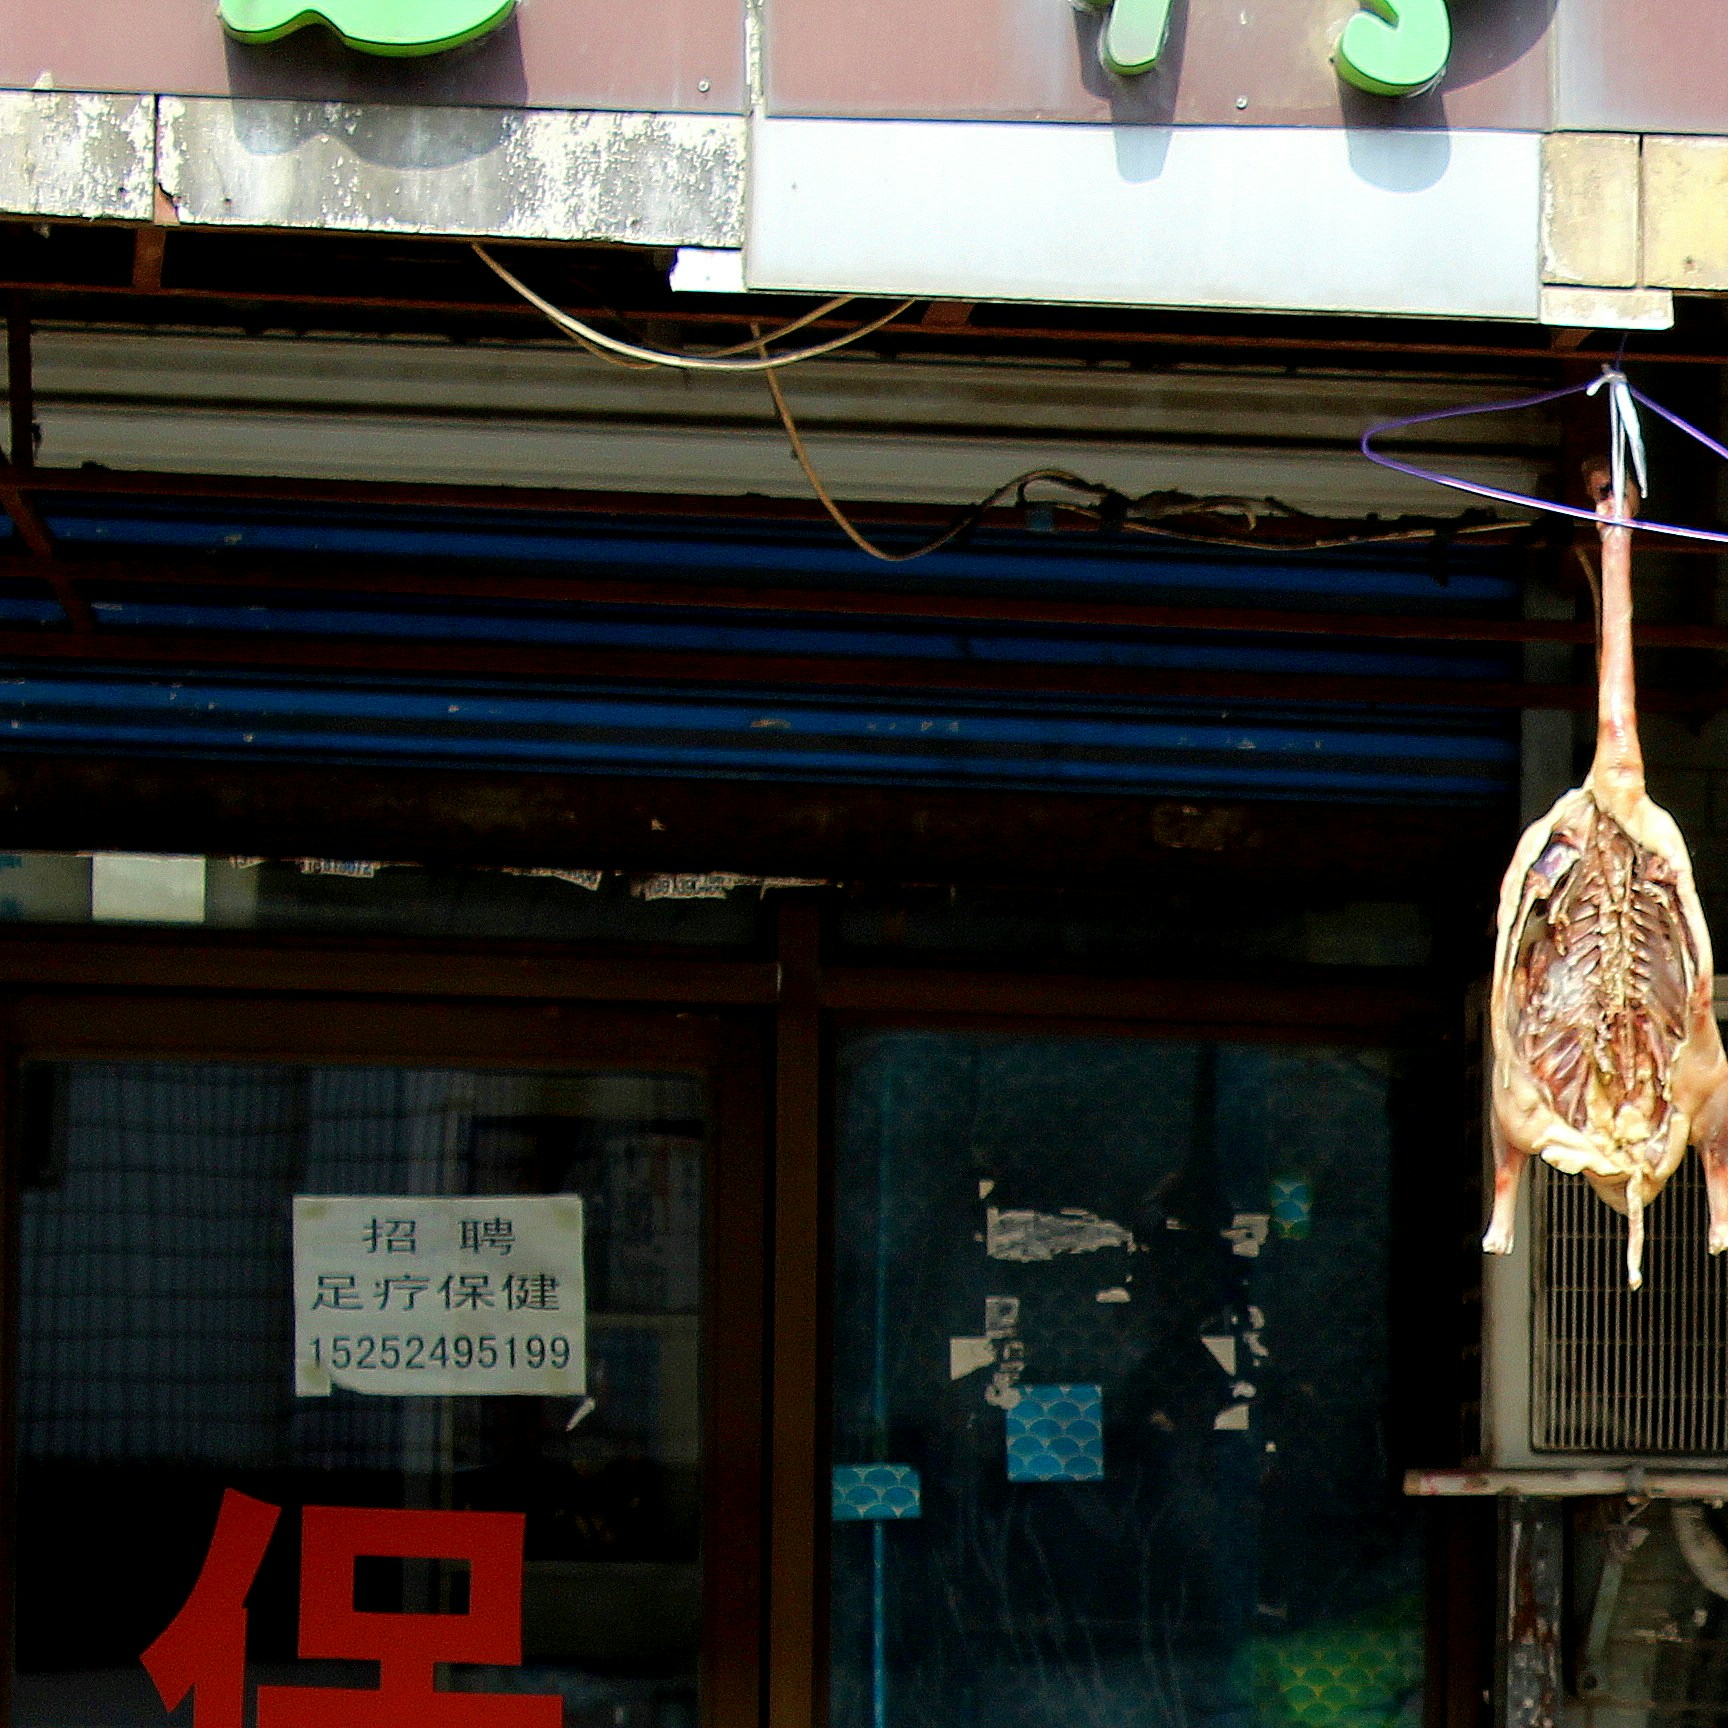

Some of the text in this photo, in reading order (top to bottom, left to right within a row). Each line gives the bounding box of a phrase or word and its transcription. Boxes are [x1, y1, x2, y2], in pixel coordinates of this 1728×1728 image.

[361, 1215, 516, 1255] 招聘
[310, 1271, 560, 1311] 足疗保健
[310, 1333, 571, 1370] 15252495199
